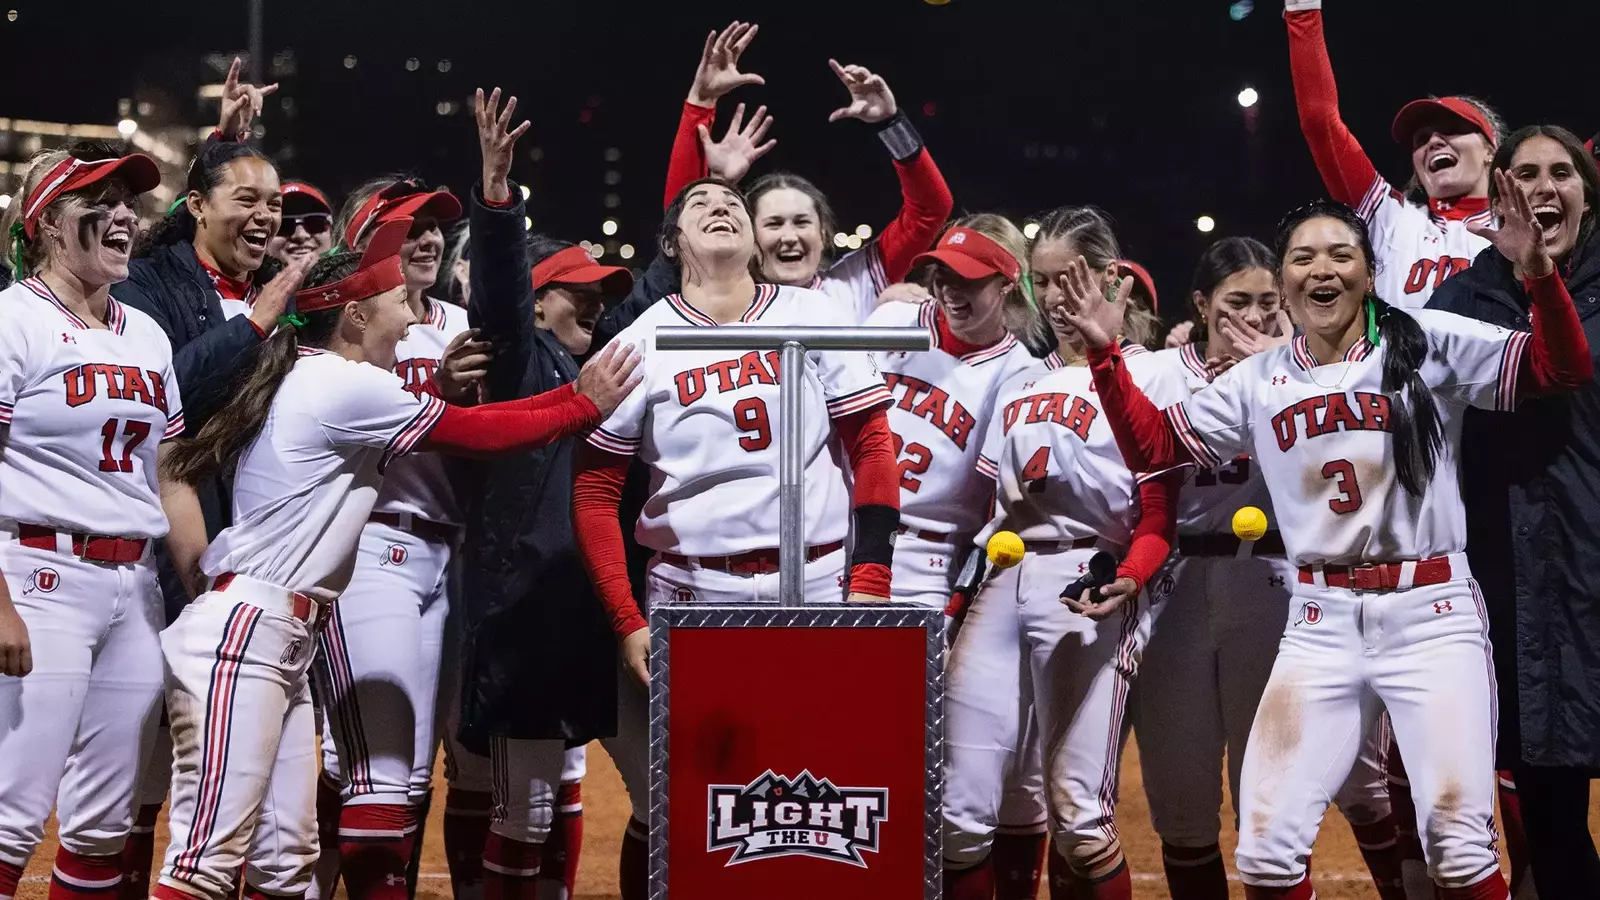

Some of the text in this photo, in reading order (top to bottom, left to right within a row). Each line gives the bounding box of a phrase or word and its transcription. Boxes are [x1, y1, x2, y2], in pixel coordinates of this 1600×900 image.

[1404, 255, 1471, 295] UT
[394, 357, 439, 403] UT
[733, 396, 772, 453] 9
[881, 372, 976, 453] TAH
[1003, 392, 1098, 443] UTAH
[1270, 391, 1393, 453] UTAH
[98, 417, 152, 473] 17
[1022, 446, 1051, 493] 4
[1321, 458, 1363, 515] 3
[717, 794, 879, 841] LIGHT
[766, 830, 829, 846] THE U
